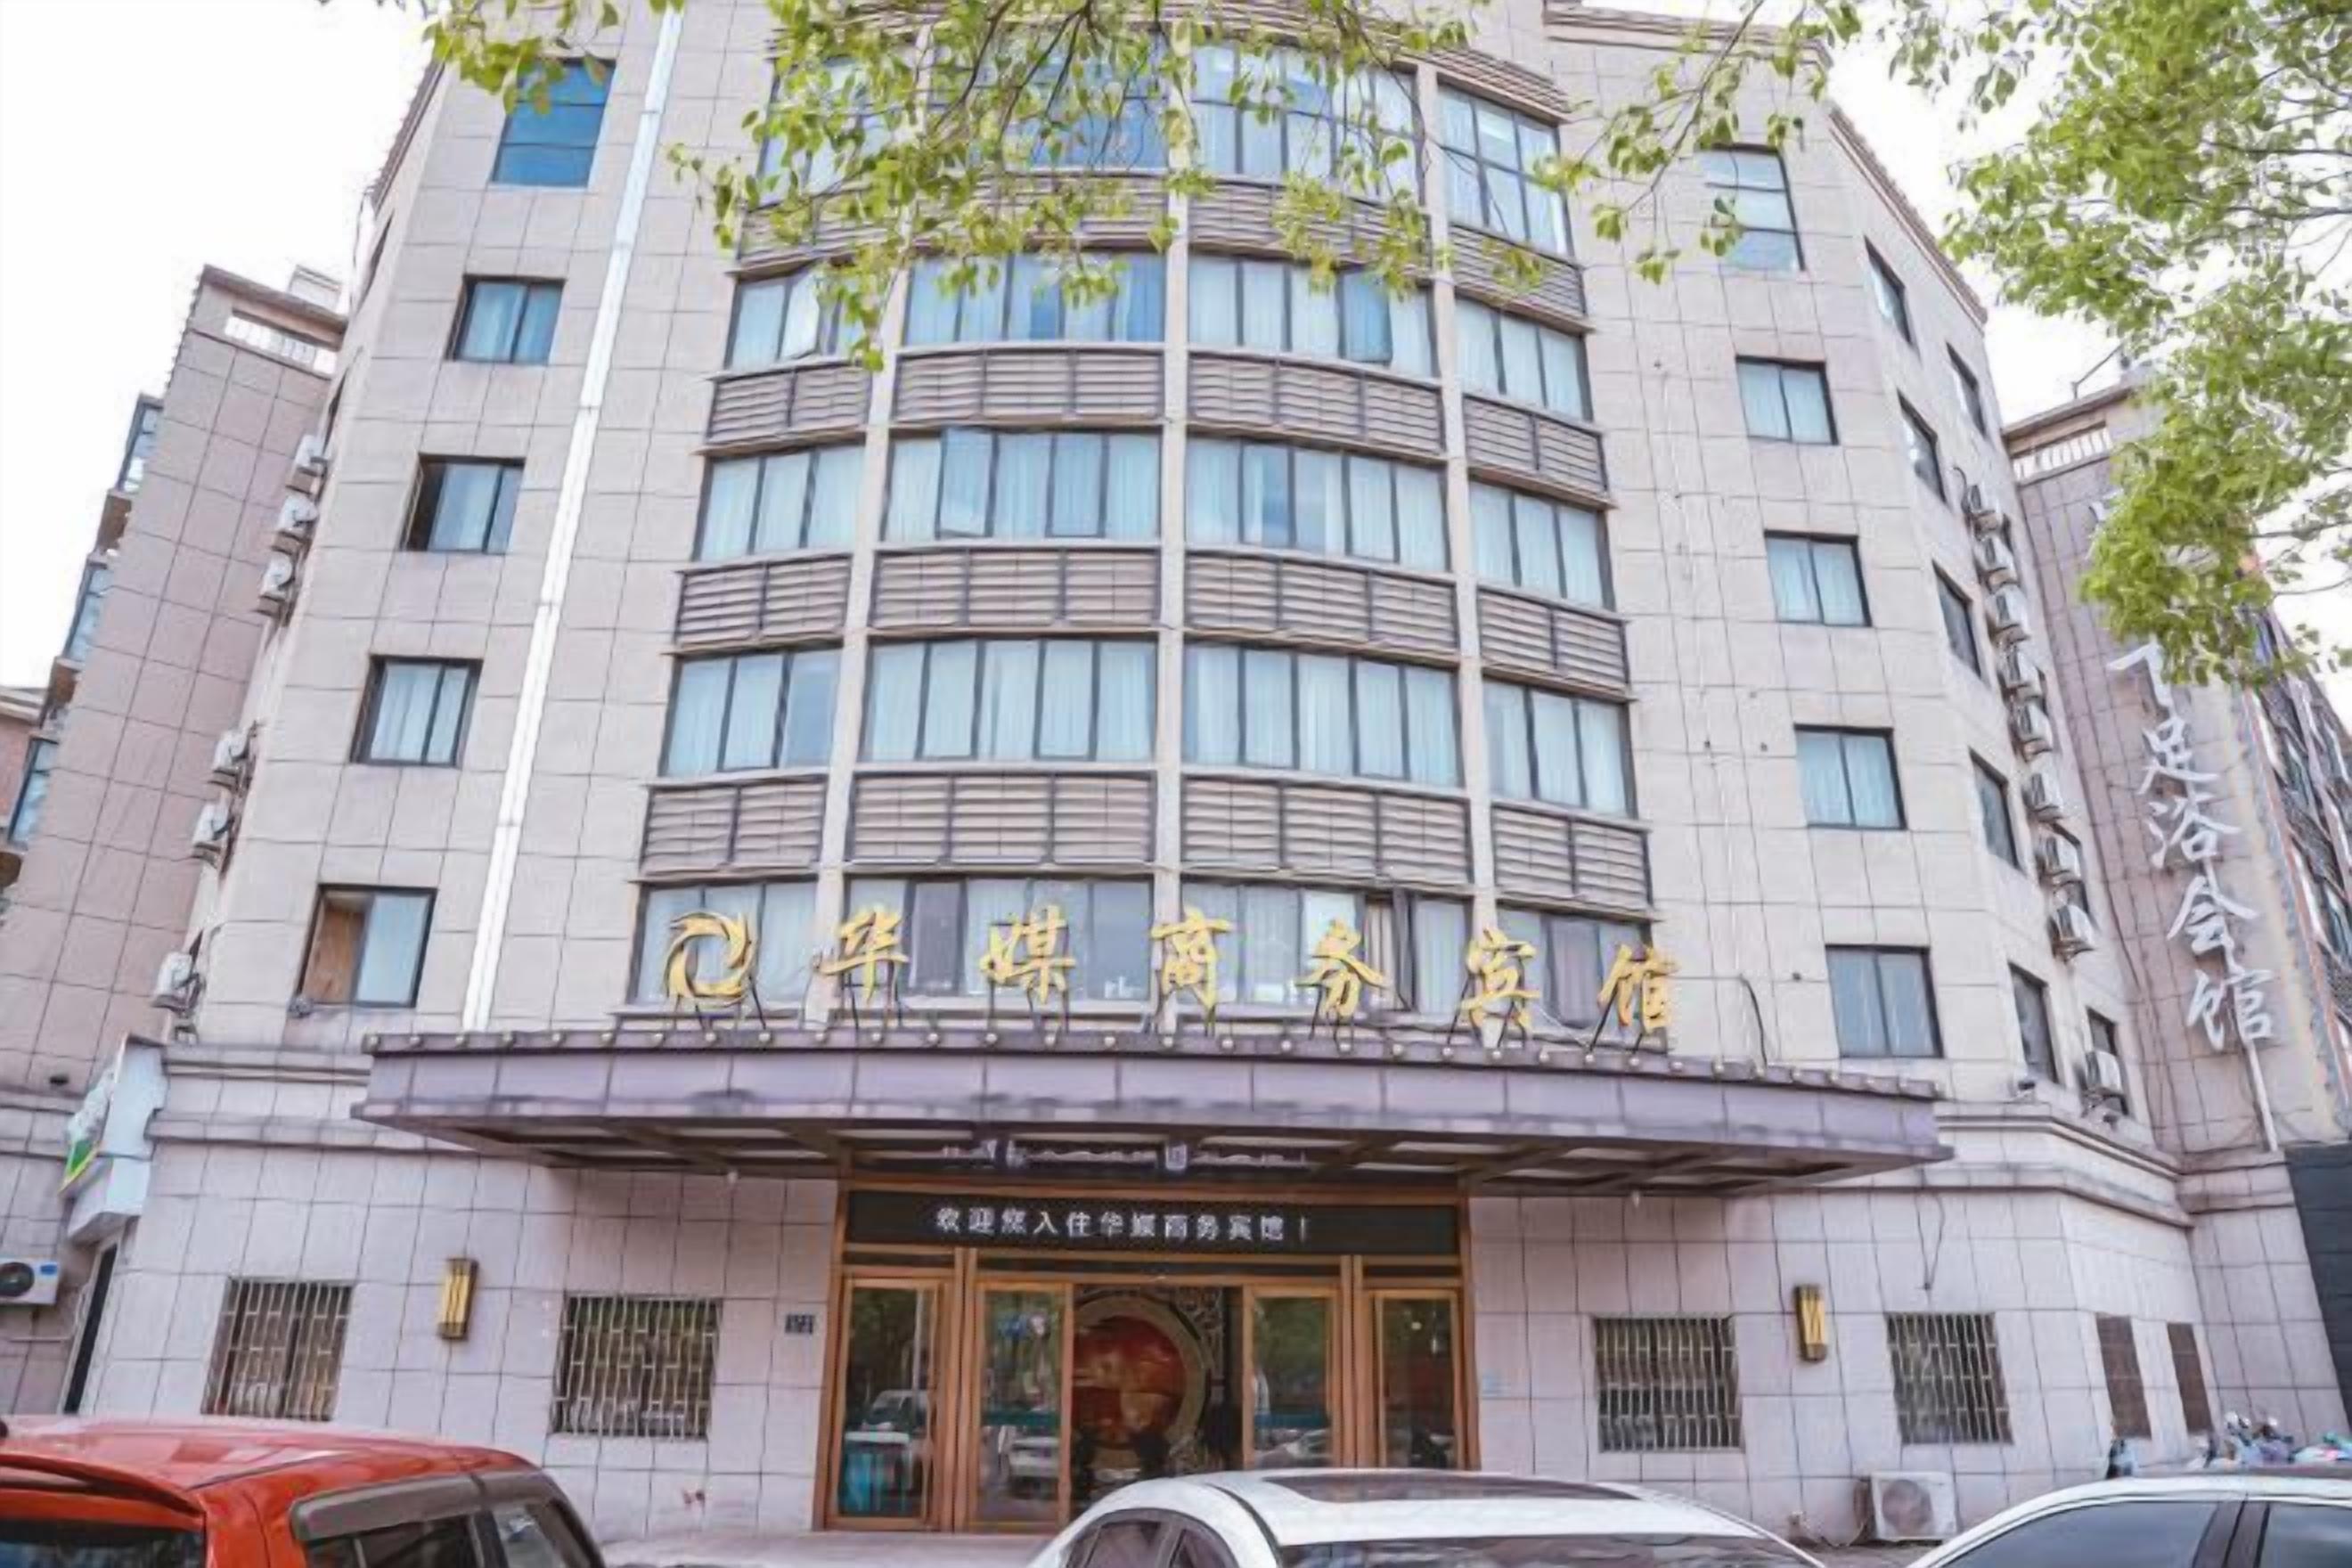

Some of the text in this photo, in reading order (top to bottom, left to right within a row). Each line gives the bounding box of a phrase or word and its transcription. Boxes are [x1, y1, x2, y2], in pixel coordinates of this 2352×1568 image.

[821, 905, 1678, 1033] 华媒商务宾馆
